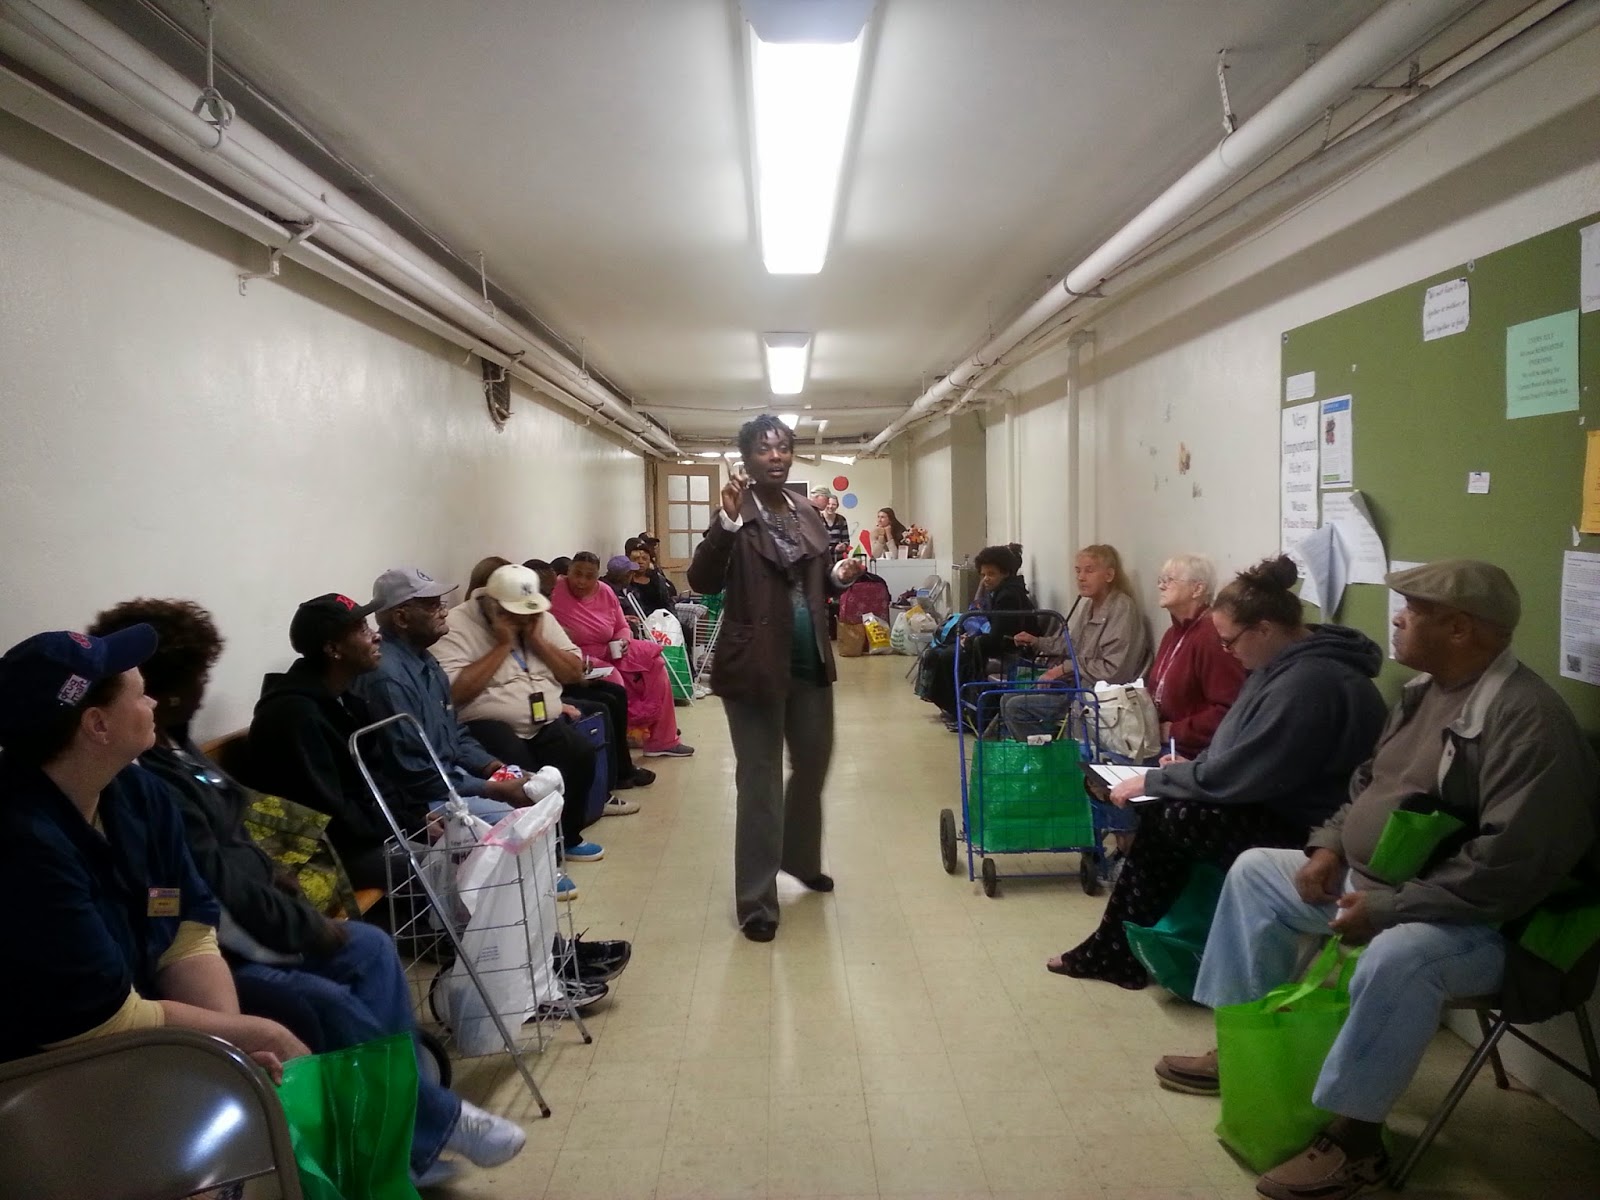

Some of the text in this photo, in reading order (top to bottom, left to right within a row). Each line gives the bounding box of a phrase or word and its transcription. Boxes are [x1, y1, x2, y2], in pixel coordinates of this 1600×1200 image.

[1292, 412, 1308, 429] Very
[1283, 440, 1317, 456] Important
[61, 680, 79, 699] drug
[71, 680, 88, 702] mart
